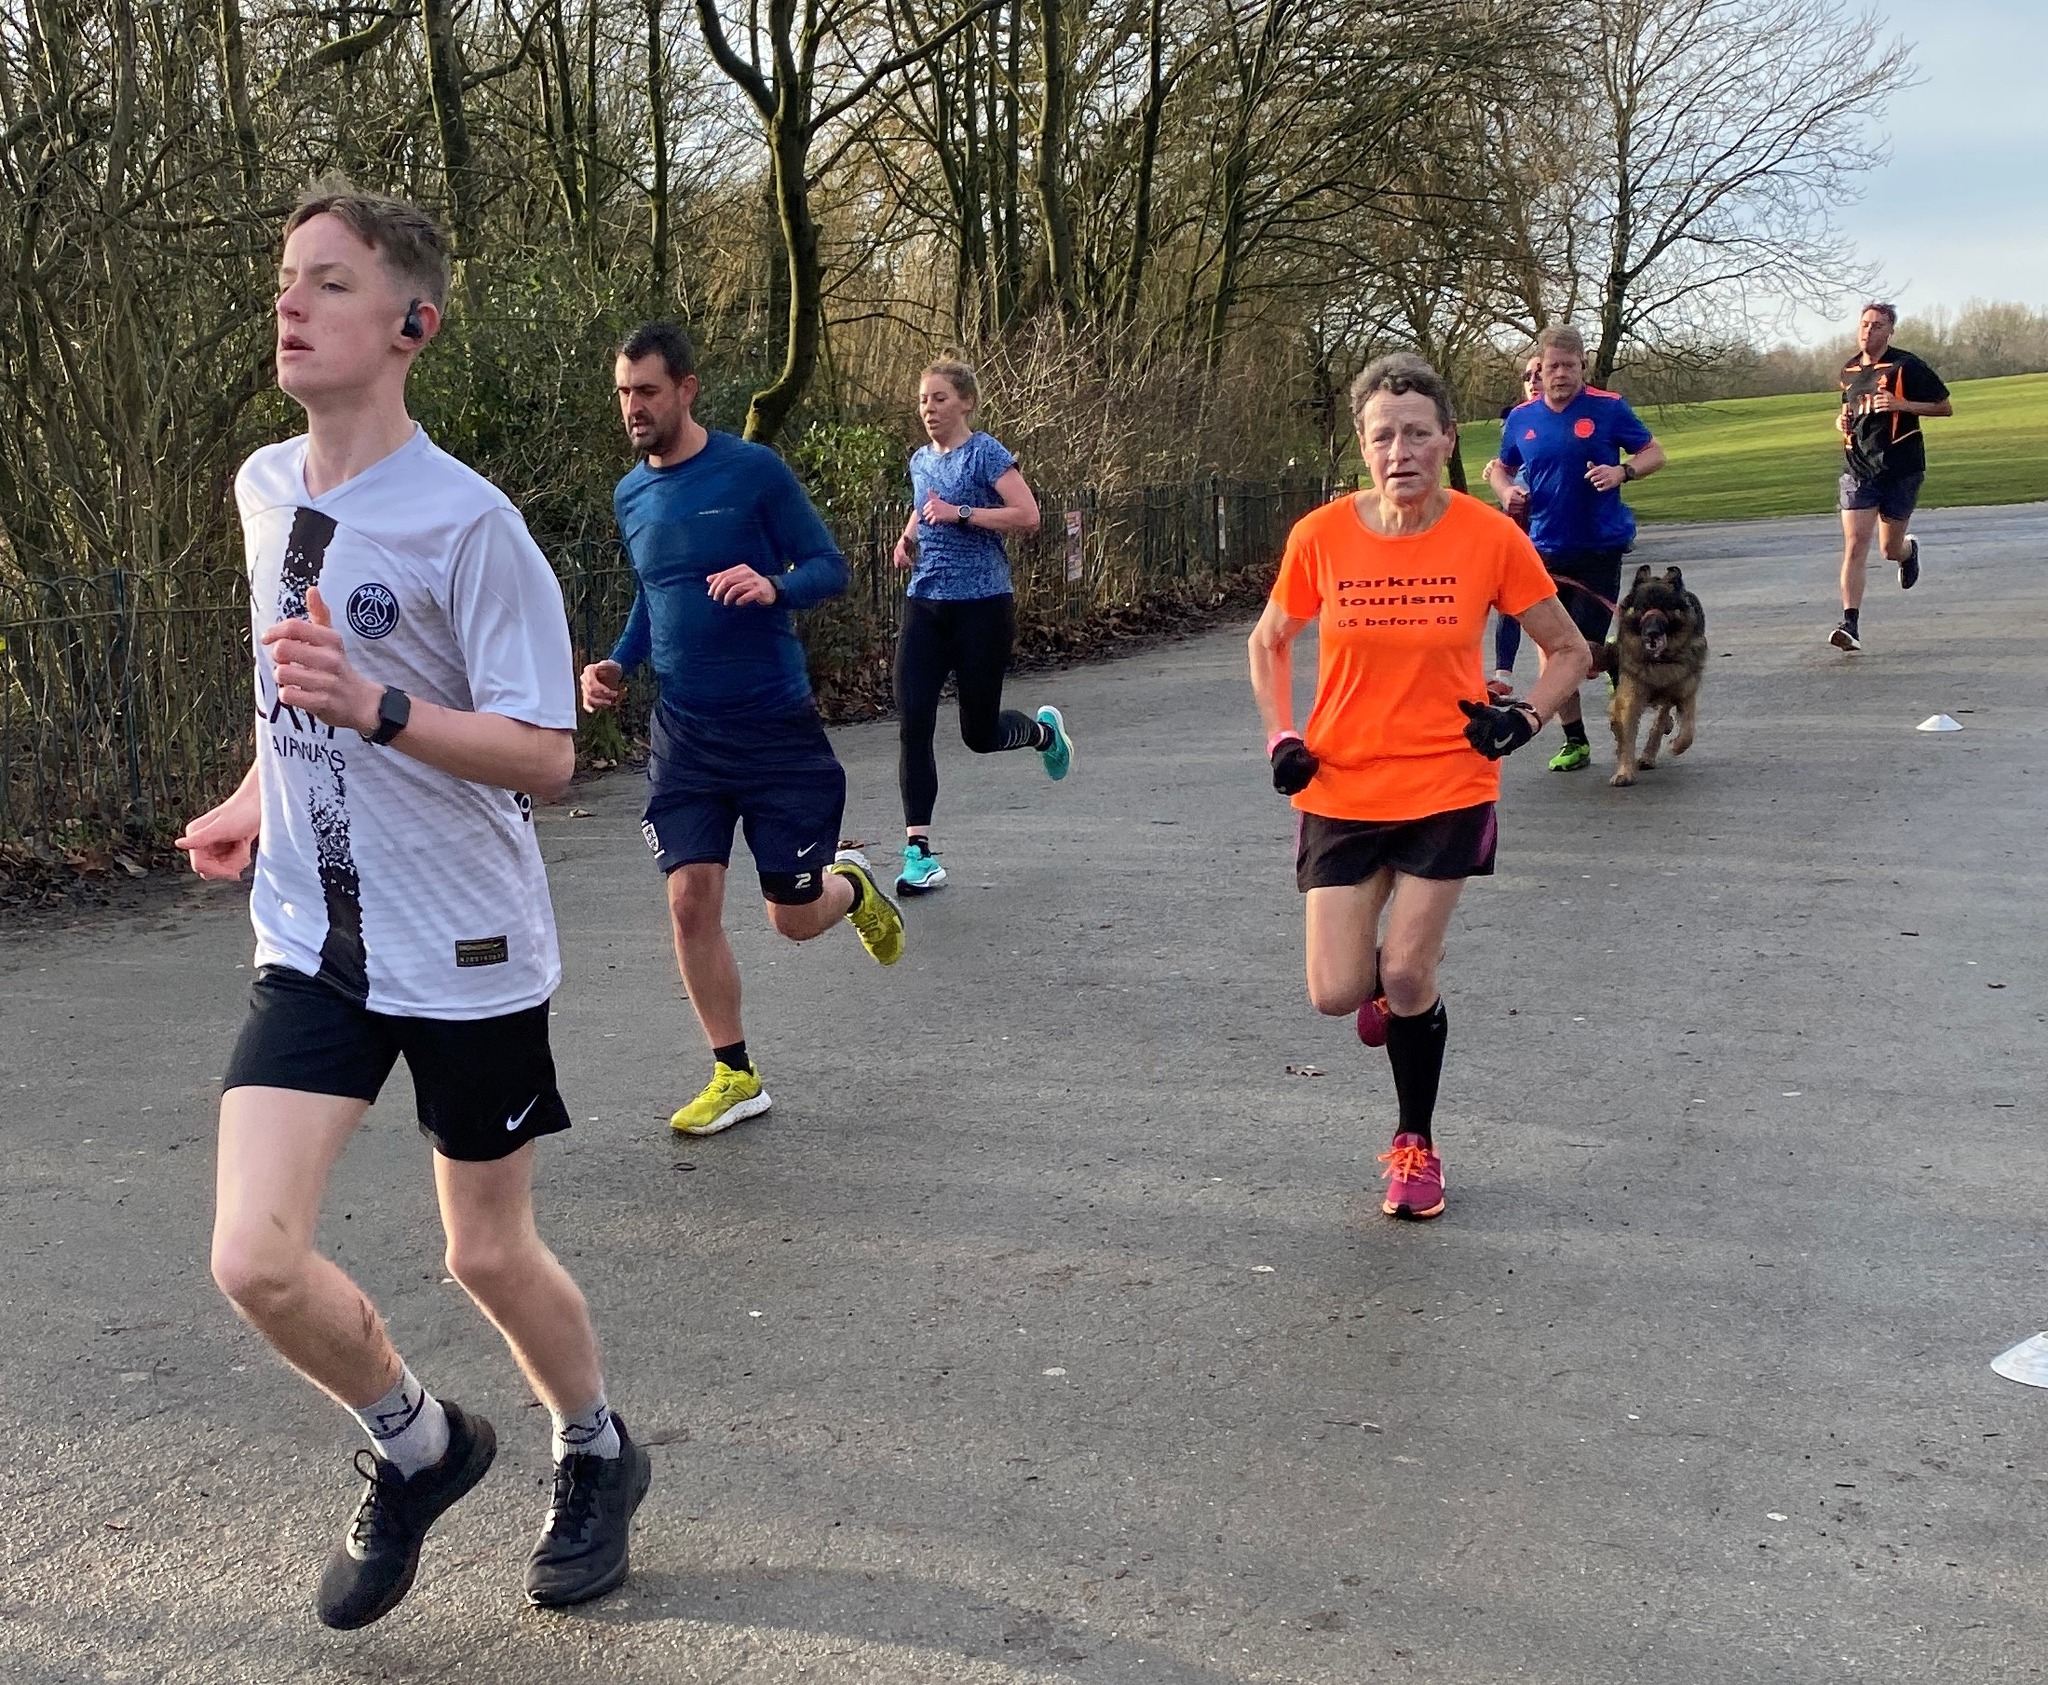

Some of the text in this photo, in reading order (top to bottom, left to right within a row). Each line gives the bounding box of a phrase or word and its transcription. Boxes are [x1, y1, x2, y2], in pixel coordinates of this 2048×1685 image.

[1337, 576, 1457, 591] parkrun
[359, 587, 392, 606] PARIS
[1338, 594, 1455, 607] tourism
[1338, 616, 1458, 628] 65 before 65
